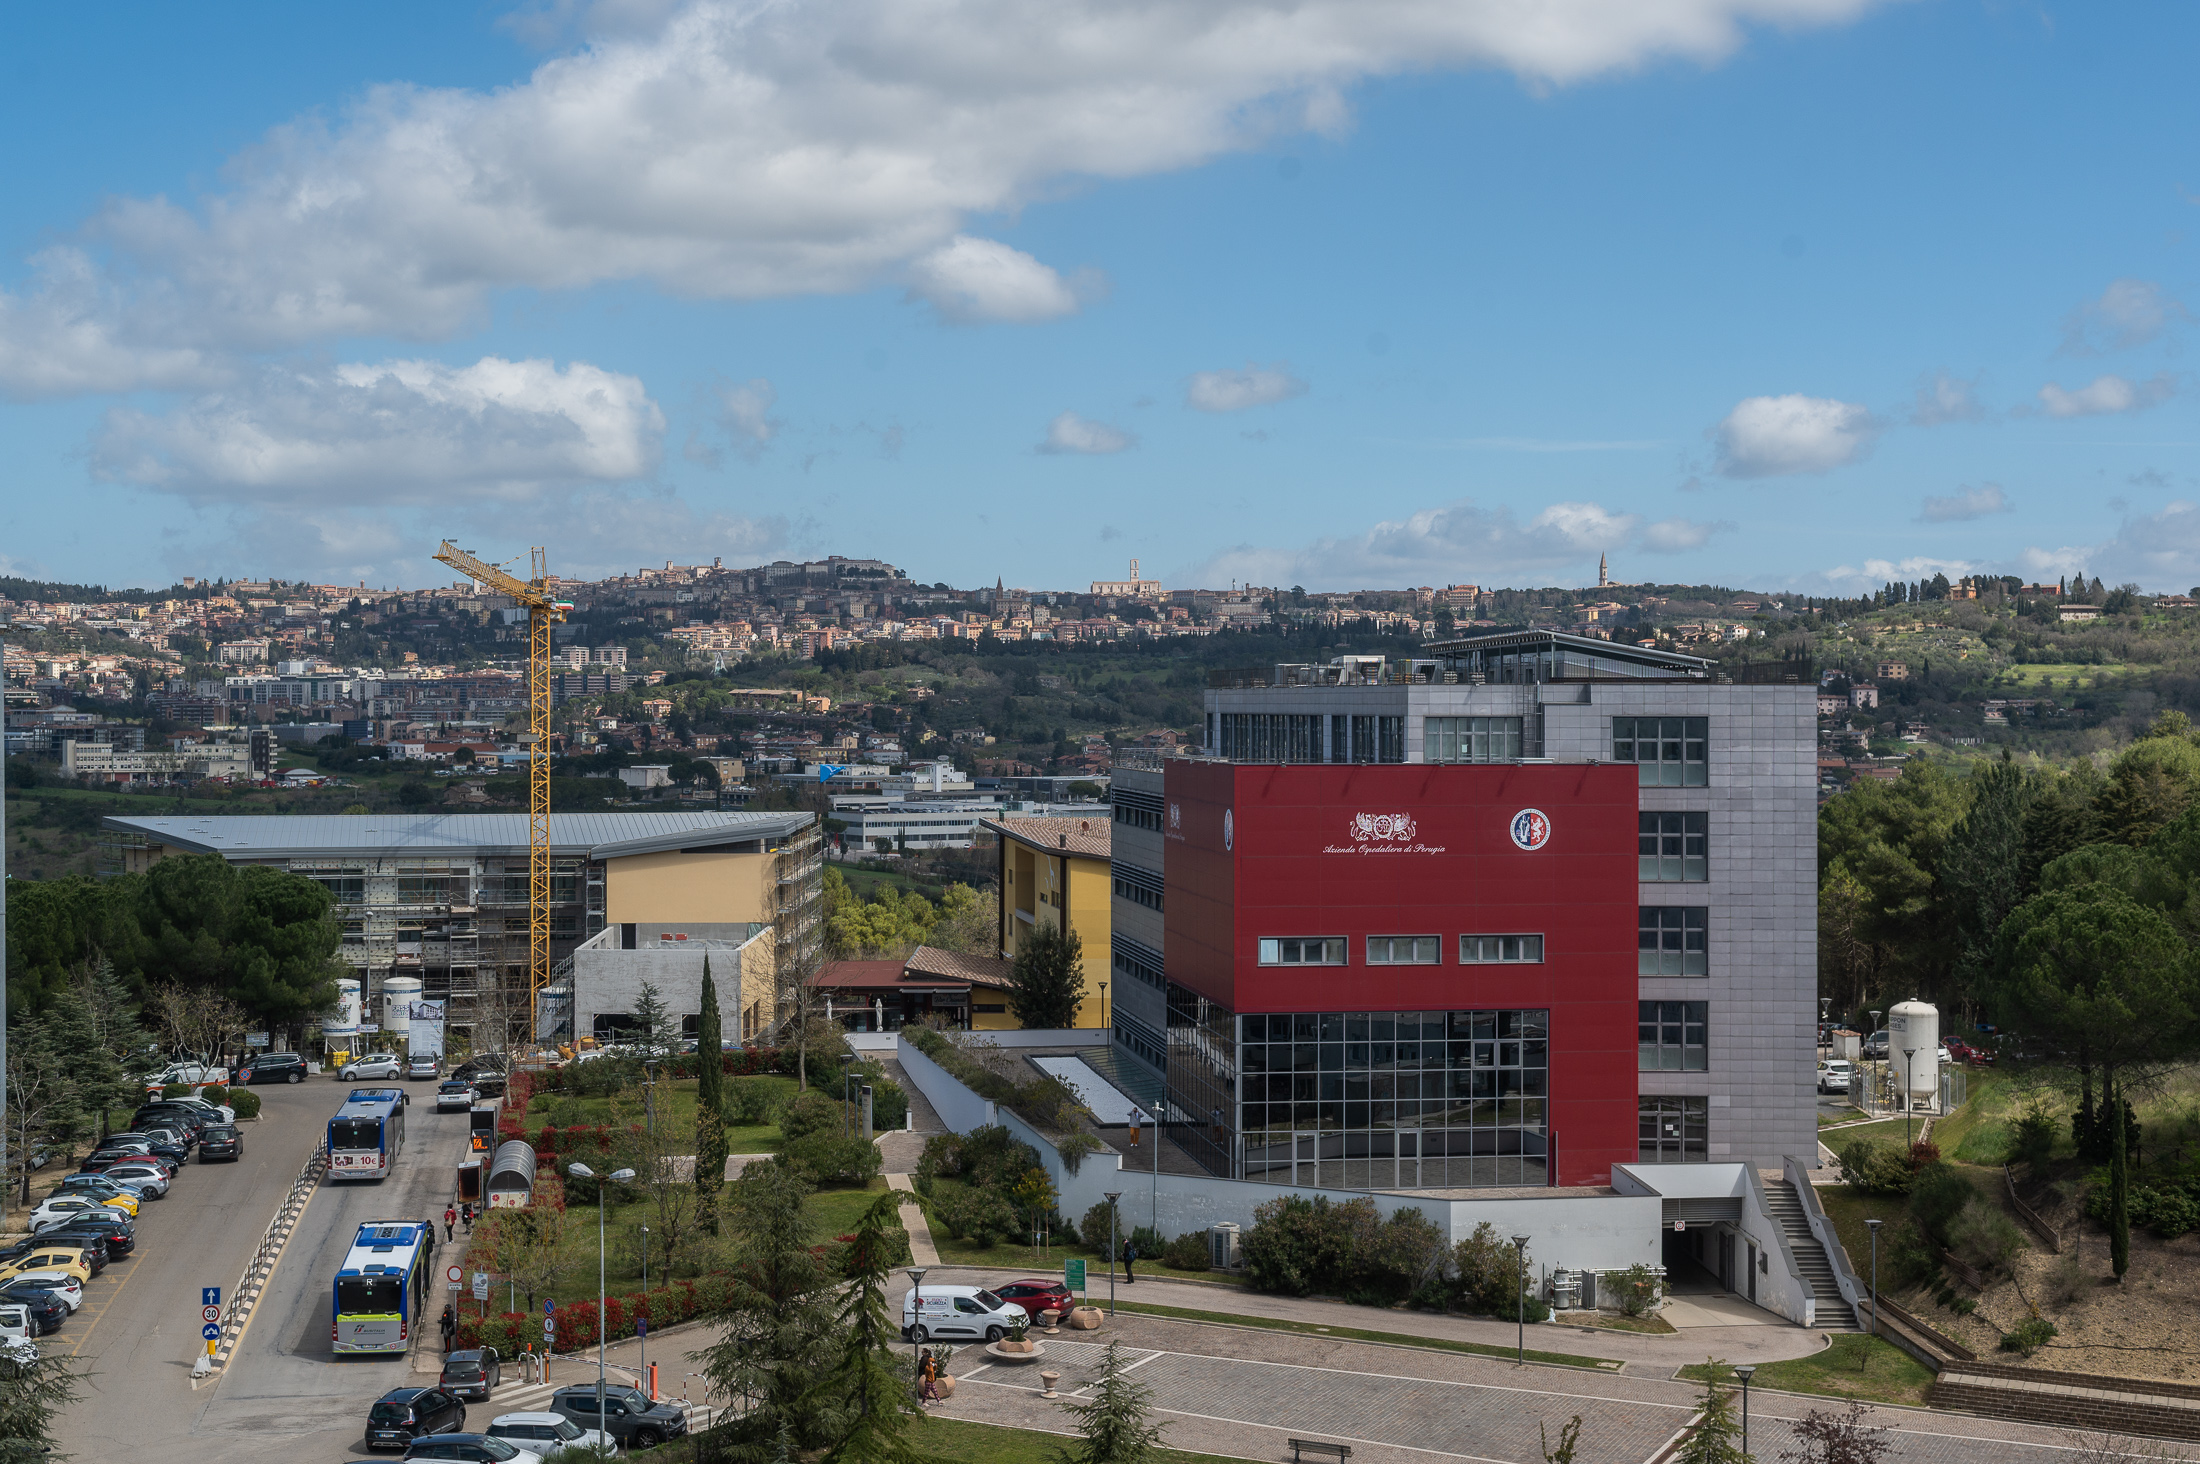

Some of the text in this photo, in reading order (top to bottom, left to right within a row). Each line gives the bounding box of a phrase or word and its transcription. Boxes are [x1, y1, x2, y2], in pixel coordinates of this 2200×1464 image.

[1323, 844, 1356, 853] Azienda
[1403, 844, 1412, 853] di
[1413, 843, 1446, 855] Perugia
[206, 1309, 217, 1319] 30
